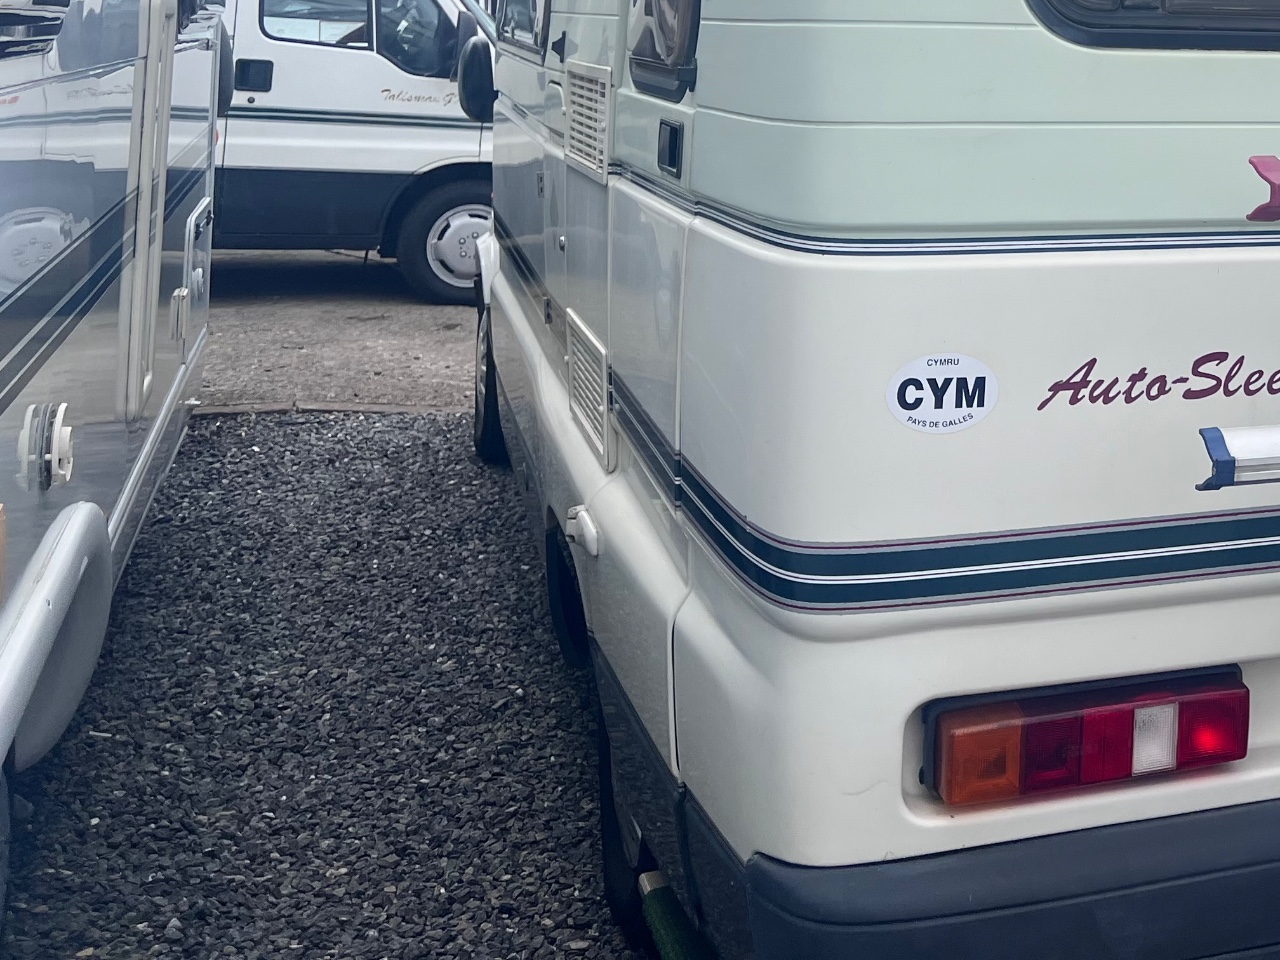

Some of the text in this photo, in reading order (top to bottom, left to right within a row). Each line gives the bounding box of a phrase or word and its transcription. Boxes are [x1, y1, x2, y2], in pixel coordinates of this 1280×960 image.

[381, 88, 441, 103] Talisman
[926, 358, 960, 367] CYMRU
[896, 376, 987, 411] CYM
[906, 416, 927, 428] PAYS
[941, 412, 974, 428] GALLES
